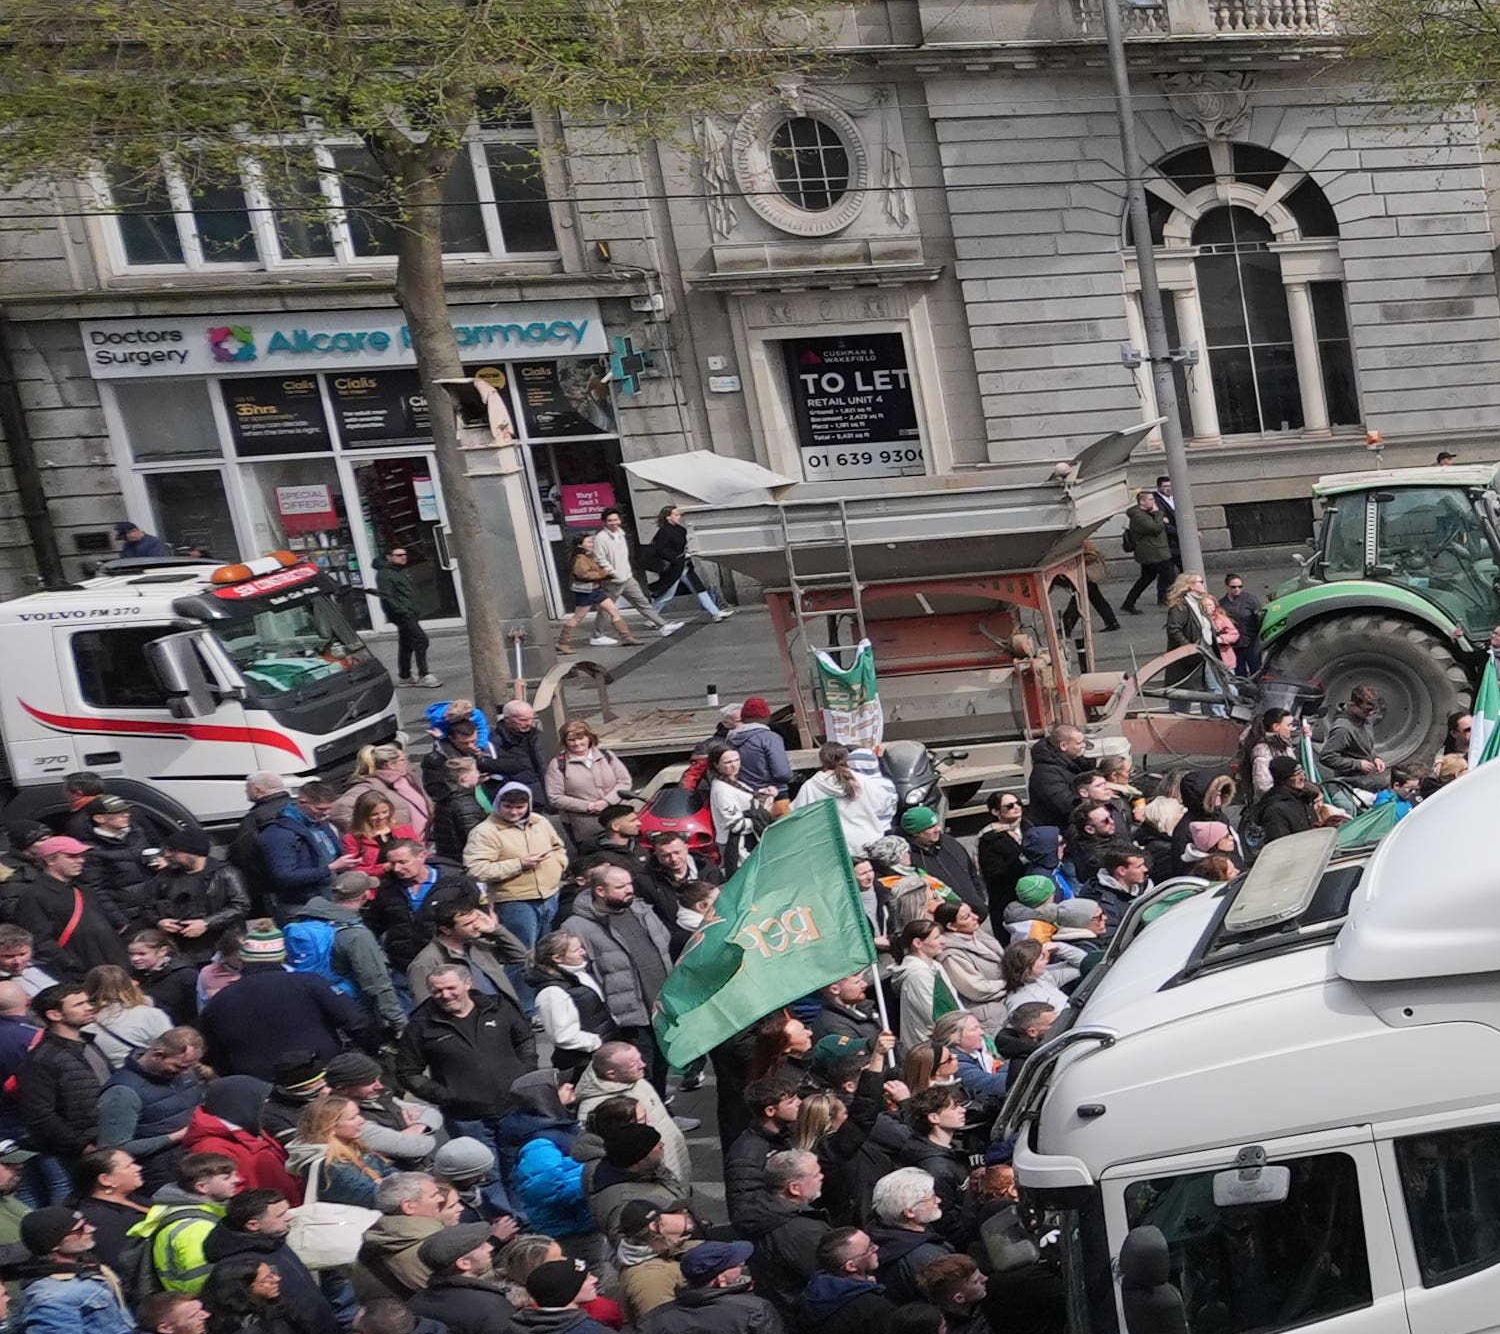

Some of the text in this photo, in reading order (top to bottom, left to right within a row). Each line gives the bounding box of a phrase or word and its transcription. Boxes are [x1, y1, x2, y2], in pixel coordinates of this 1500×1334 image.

[90, 328, 183, 345] Doctors
[267, 319, 589, 355] Allcare armacy
[95, 348, 189, 365] Surgery
[823, 349, 867, 357] CUSHMAN
[824, 355, 877, 364] WAKEFIELD
[282, 380, 316, 391] Cialis
[334, 377, 378, 390] Cialis
[800, 369, 908, 394] TO LET
[807, 395, 884, 407] RETAIL UNIT 4
[808, 455, 829, 468] 01
[836, 452, 873, 466] 639
[279, 491, 326, 500] SPECIAL
[282, 500, 328, 509] OFFERS
[16, 605, 141, 622] VOLVO FM 370
[34, 755, 69, 766] 370
